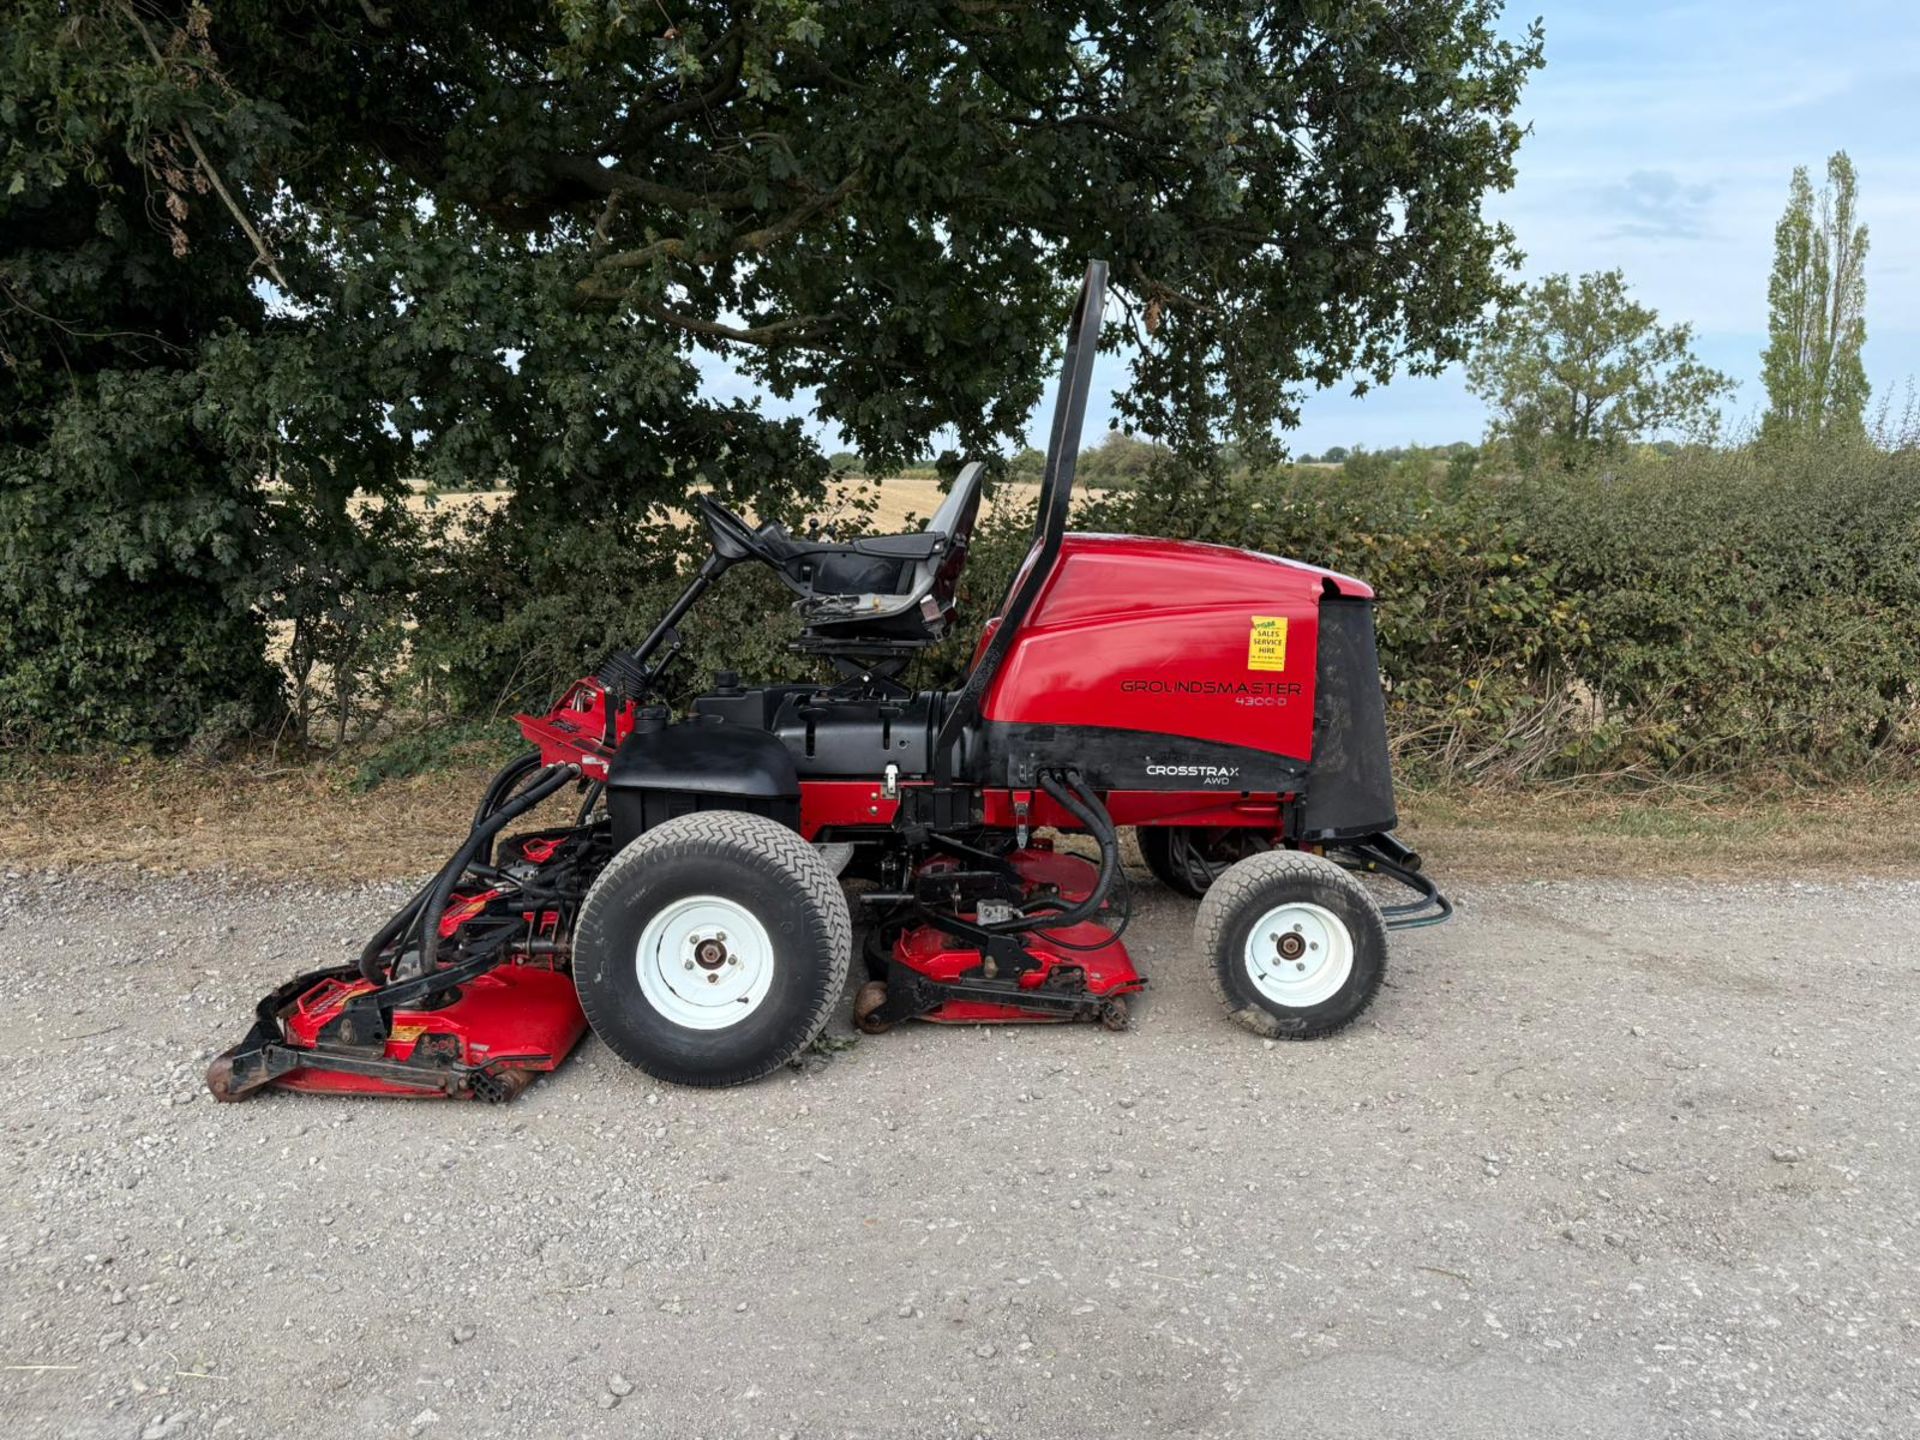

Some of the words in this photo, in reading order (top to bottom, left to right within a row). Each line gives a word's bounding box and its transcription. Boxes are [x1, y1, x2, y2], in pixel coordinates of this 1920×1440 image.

[1257, 630, 1280, 638] SALES
[1120, 680, 1302, 696] GROUNDSMASTER
[1146, 765, 1239, 777] CROSSTRAX
[1204, 777, 1229, 785] AWD
